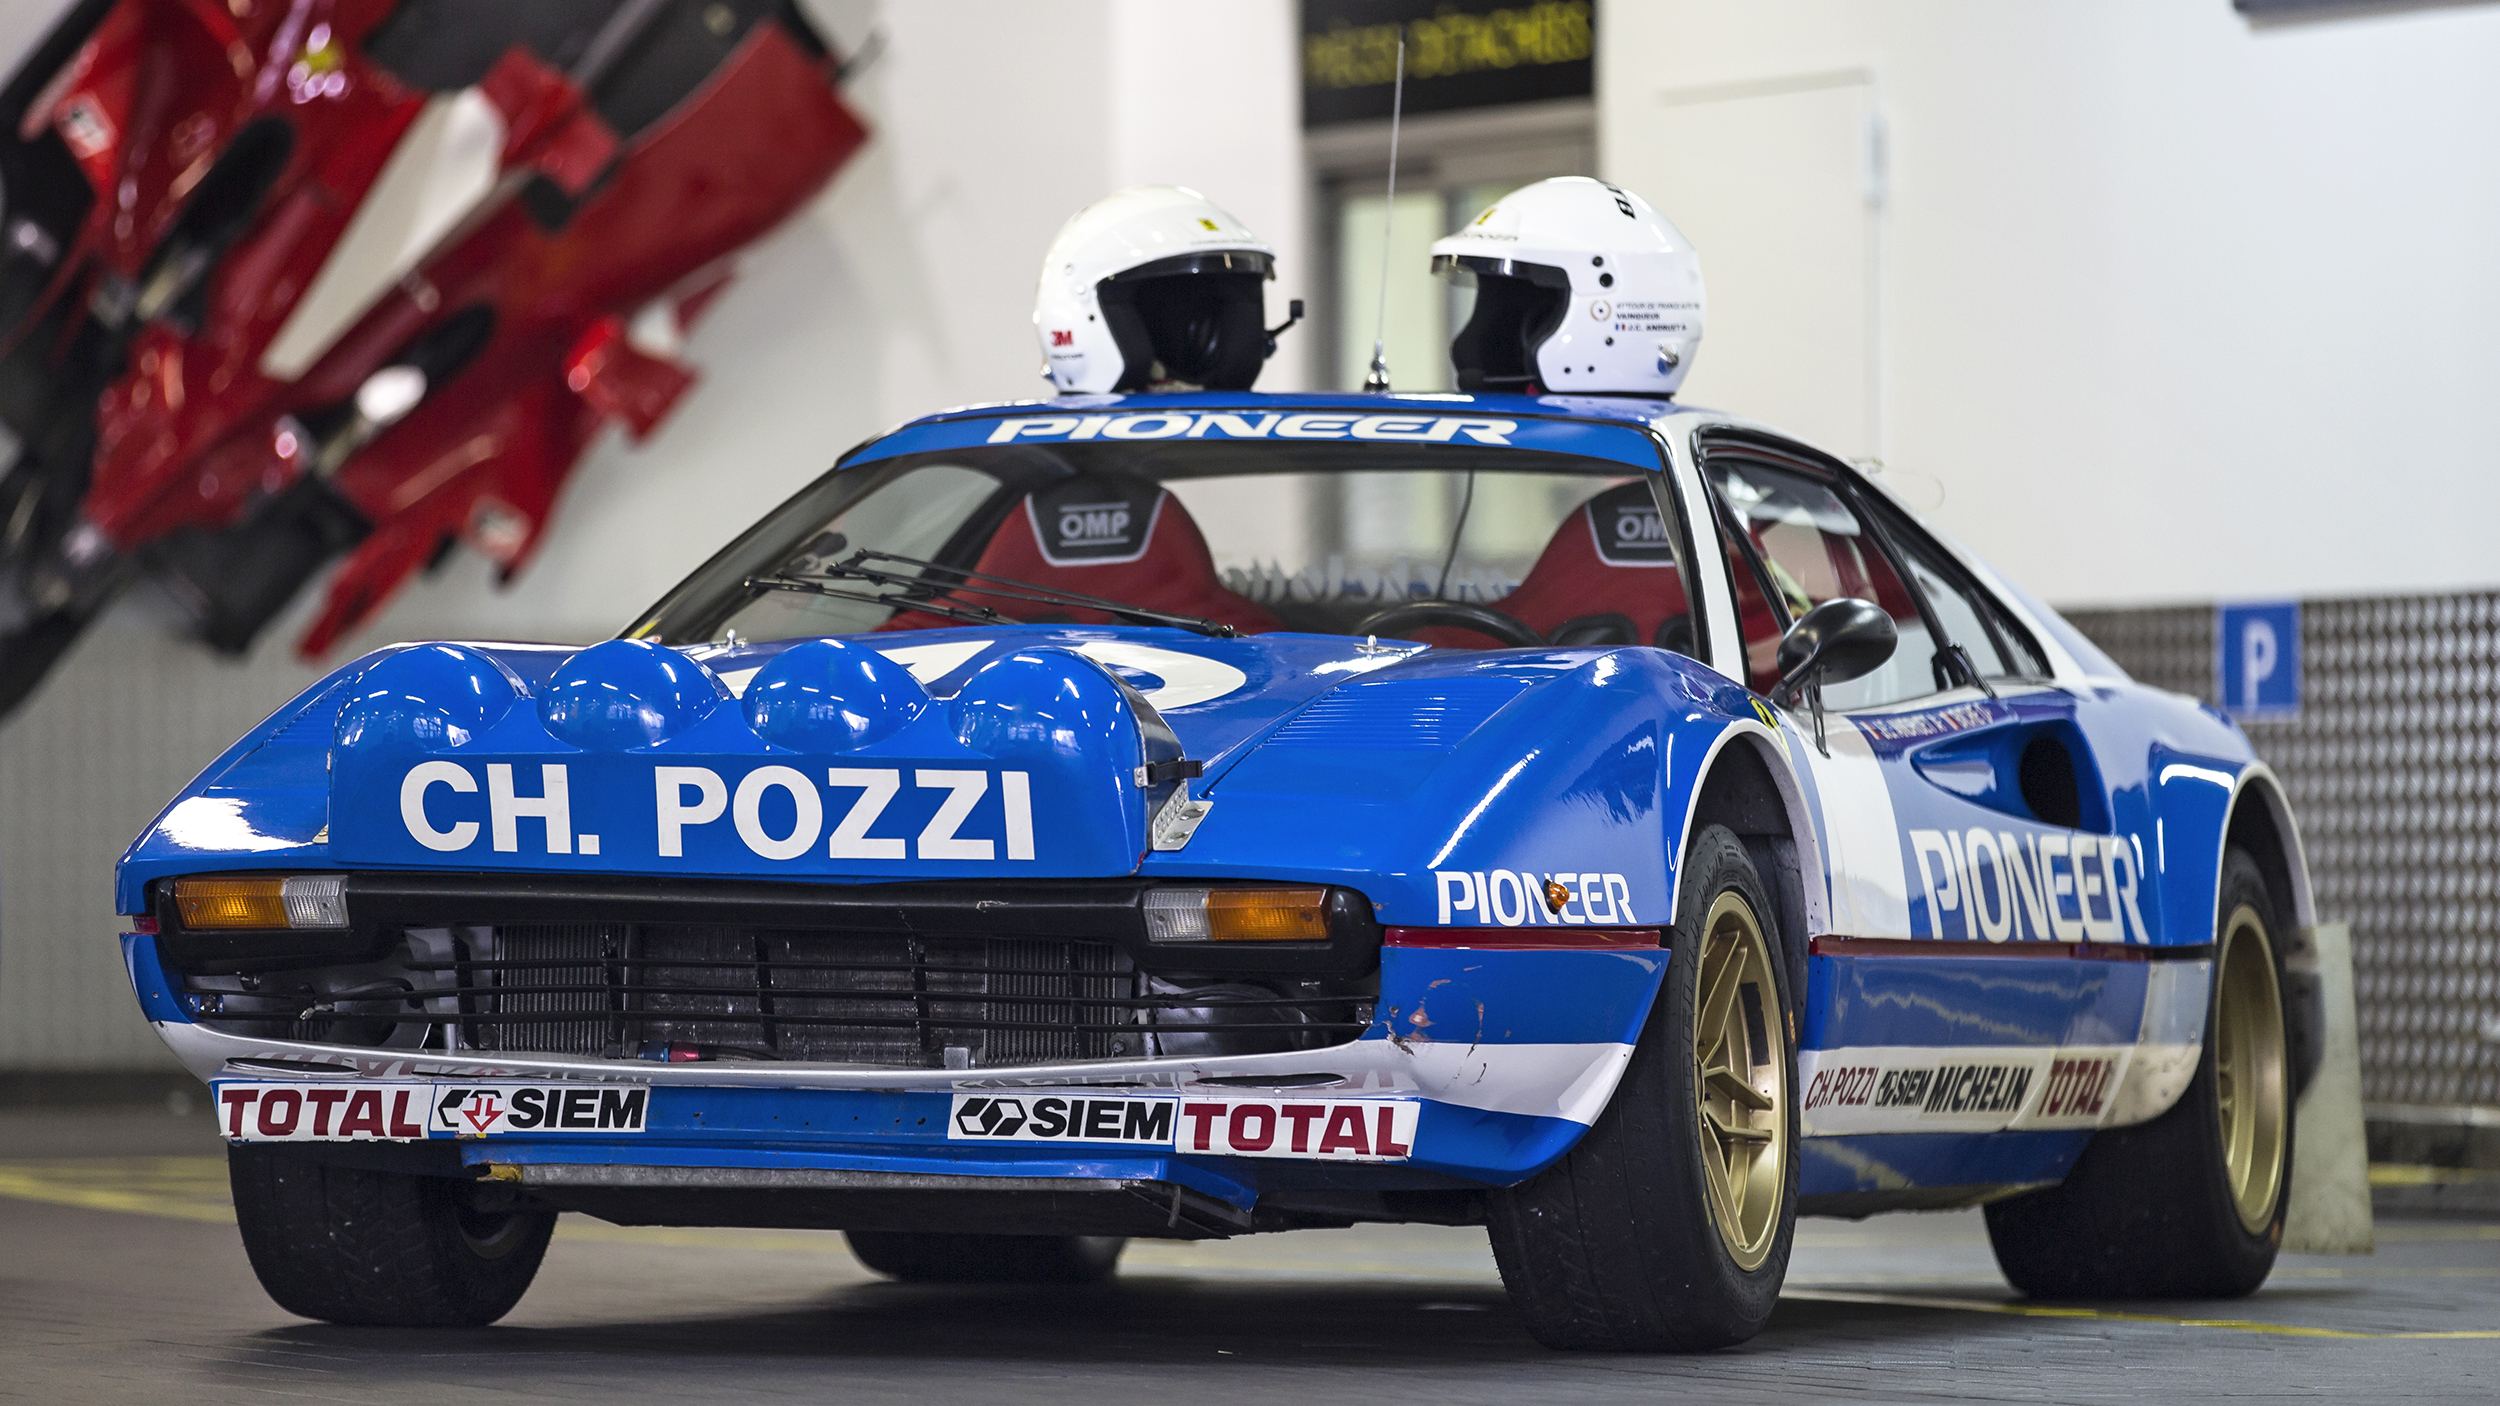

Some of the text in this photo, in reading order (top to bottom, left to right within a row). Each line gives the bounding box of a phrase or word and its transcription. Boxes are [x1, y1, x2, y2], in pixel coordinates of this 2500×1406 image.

[1051, 330, 1073, 347] 3M
[986, 414, 1519, 445] PIONEER
[1059, 511, 1130, 539] OMP
[1617, 514, 1667, 541] OM
[2242, 619, 2278, 714] P
[400, 761, 1035, 861] CH. POZZI
[1434, 869, 1638, 926] PIONEER
[1908, 826, 2150, 944] PIONEER
[507, 1088, 646, 1130] SIEM
[1892, 1069, 1935, 1108] SIEM
[1922, 1066, 2034, 1113] MICHELIN
[2036, 1060, 2113, 1118] TOTAL
[221, 1088, 423, 1137] TOTAL
[1028, 1098, 1171, 1140] SIEM
[1183, 1102, 1409, 1157] TOTAL
